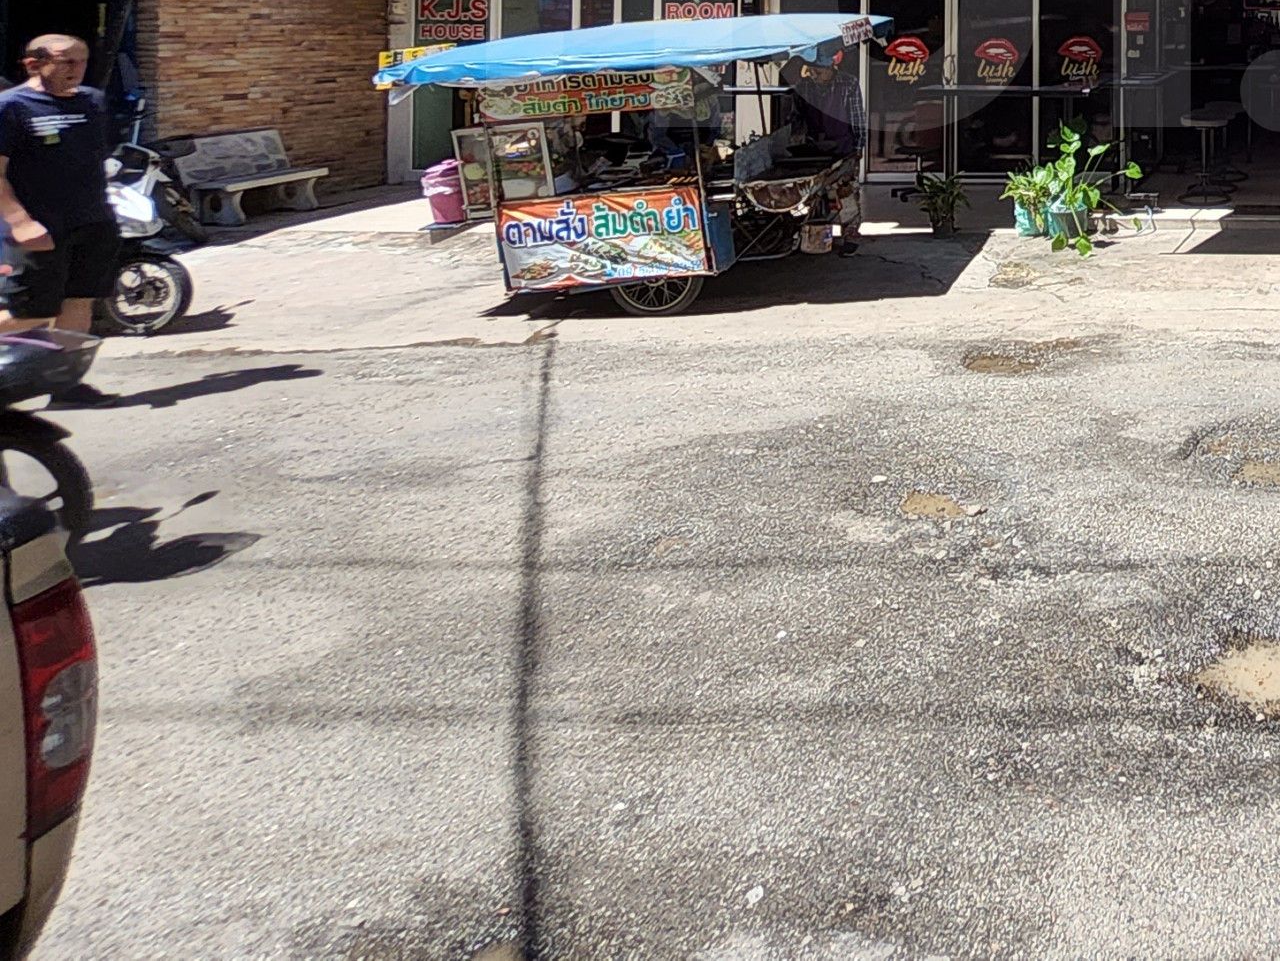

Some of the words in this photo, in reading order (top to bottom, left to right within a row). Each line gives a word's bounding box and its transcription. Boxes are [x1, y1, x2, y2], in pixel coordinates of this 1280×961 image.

[665, 2, 735, 20] ROOM
[420, 23, 486, 40] HOUSE
[888, 57, 926, 76] lush
[977, 59, 1016, 78] lush
[1061, 57, 1100, 76] lush
[503, 200, 588, 248] ตามสั่ง
[592, 200, 661, 240] ส้มตำ
[663, 195, 699, 233] ยำ
